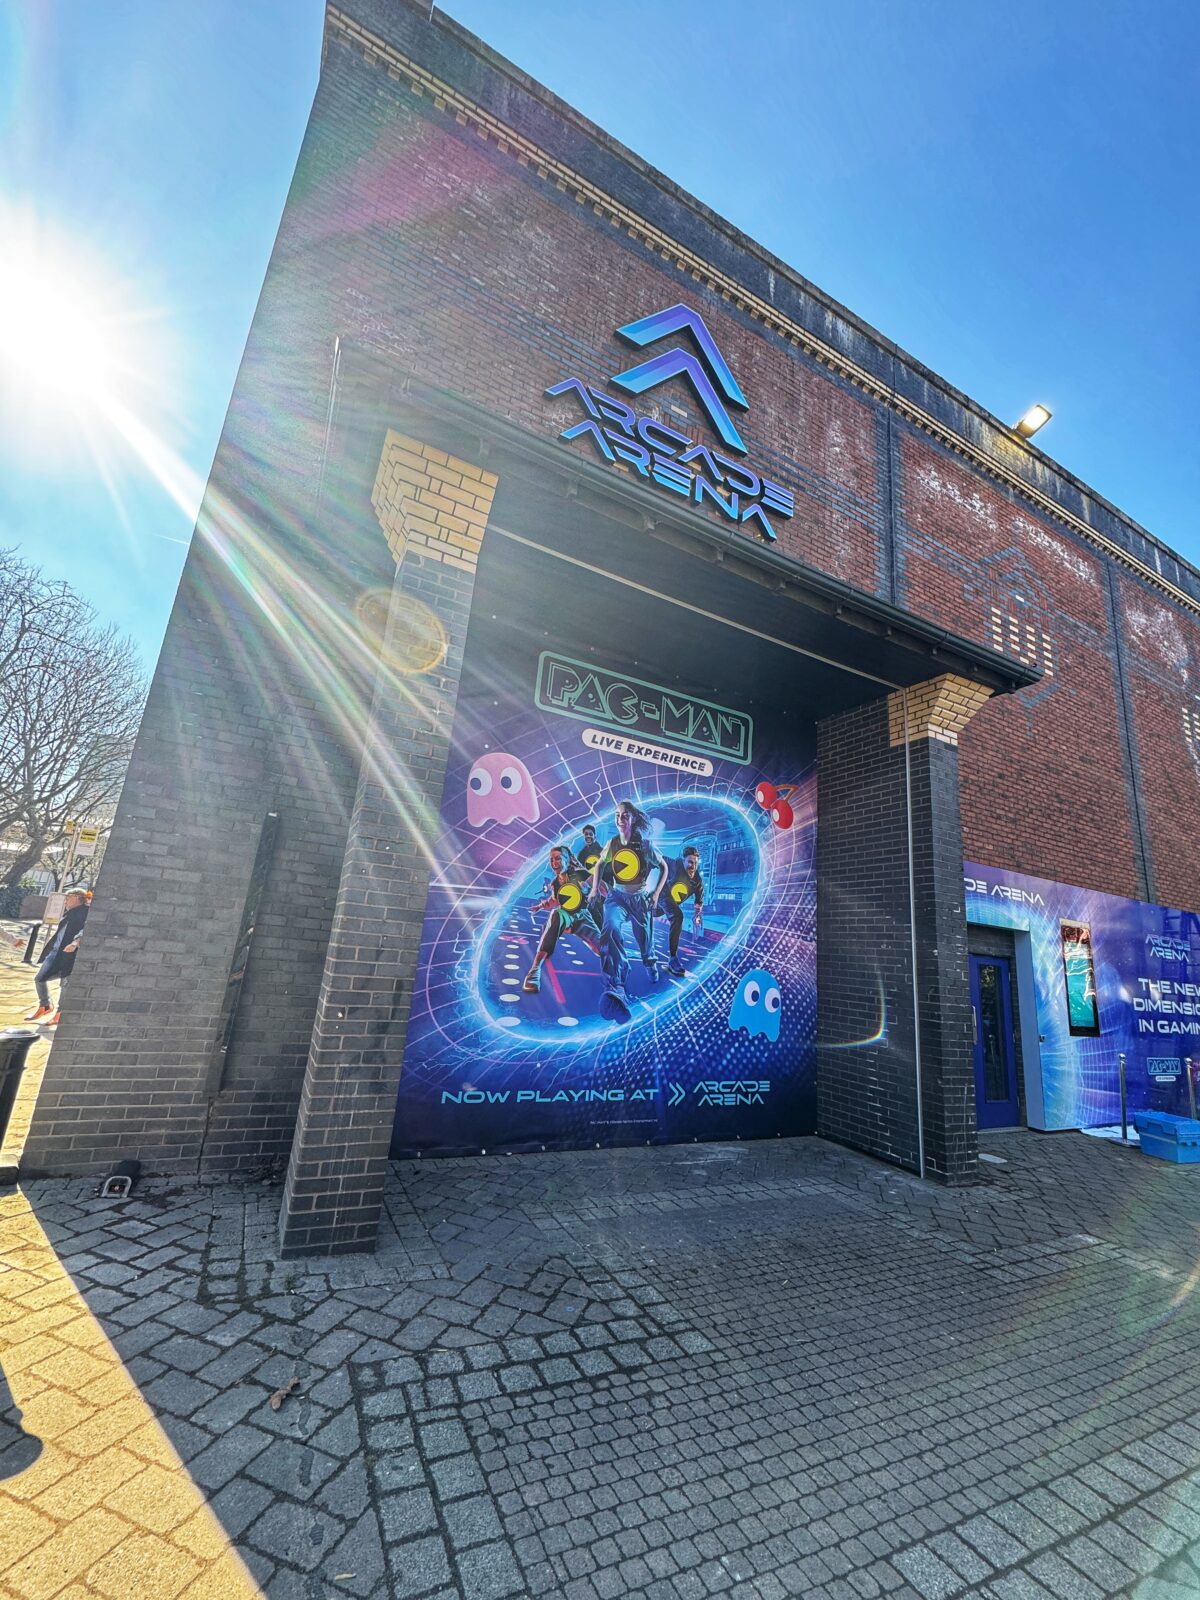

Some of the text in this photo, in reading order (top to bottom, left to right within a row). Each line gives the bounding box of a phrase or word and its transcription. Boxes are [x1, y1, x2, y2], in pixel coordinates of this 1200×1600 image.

[544, 377, 794, 518] ARCADE
[560, 420, 777, 542] ARENA
[547, 662, 745, 756] PAC-MAN
[591, 734, 706, 772] LIVE EXPERIENCE
[990, 884, 1045, 906] ARENA
[1145, 933, 1191, 951] ARCADE
[1150, 946, 1190, 963] ARENA
[1138, 977, 1172, 994] THE
[1138, 1018, 1155, 1033] IN
[693, 1080, 771, 1093] ARCADE
[441, 1088, 660, 1104] NOW PLAYING AT
[697, 1093, 765, 1106] ARENA
